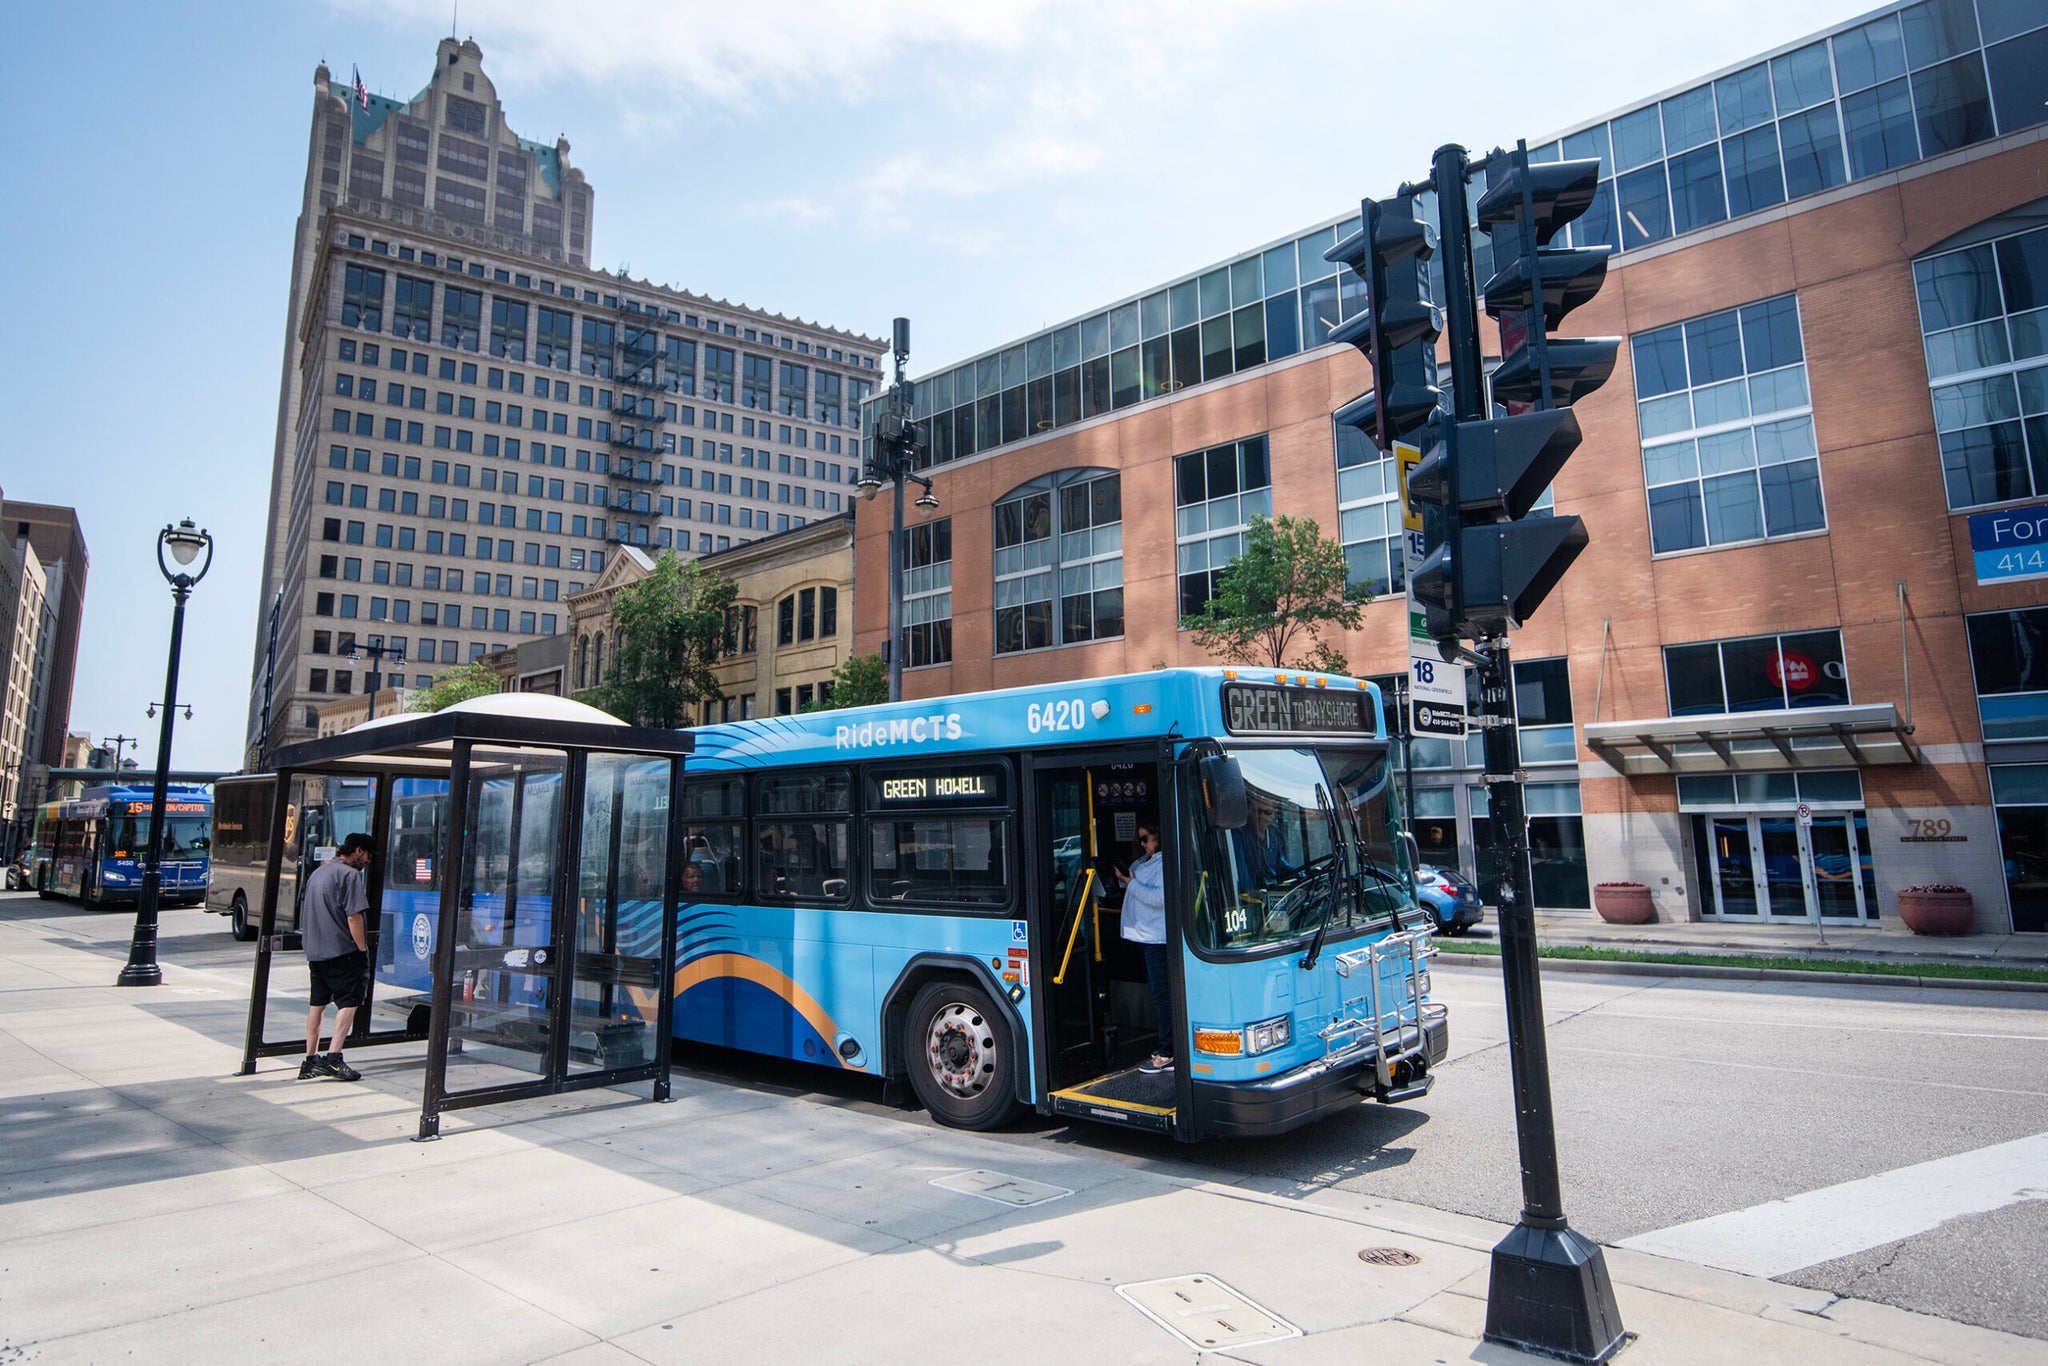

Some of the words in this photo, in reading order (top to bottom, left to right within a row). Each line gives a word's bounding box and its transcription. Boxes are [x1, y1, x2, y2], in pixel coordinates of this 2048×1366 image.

[1997, 550, 2045, 571] 414
[1414, 660, 1434, 684] 18
[1027, 698, 1085, 734] 6420
[1228, 687, 1292, 730] GREEN
[1292, 701, 1304, 722] TO
[1305, 699, 1359, 726] BAYSHORE
[836, 713, 962, 750] RideMCTS
[883, 778, 927, 799] GREEN
[935, 776, 985, 796] HOWELL
[128, 802, 143, 813] 15
[1908, 819, 1952, 837] 789
[1224, 908, 1247, 933] 104
